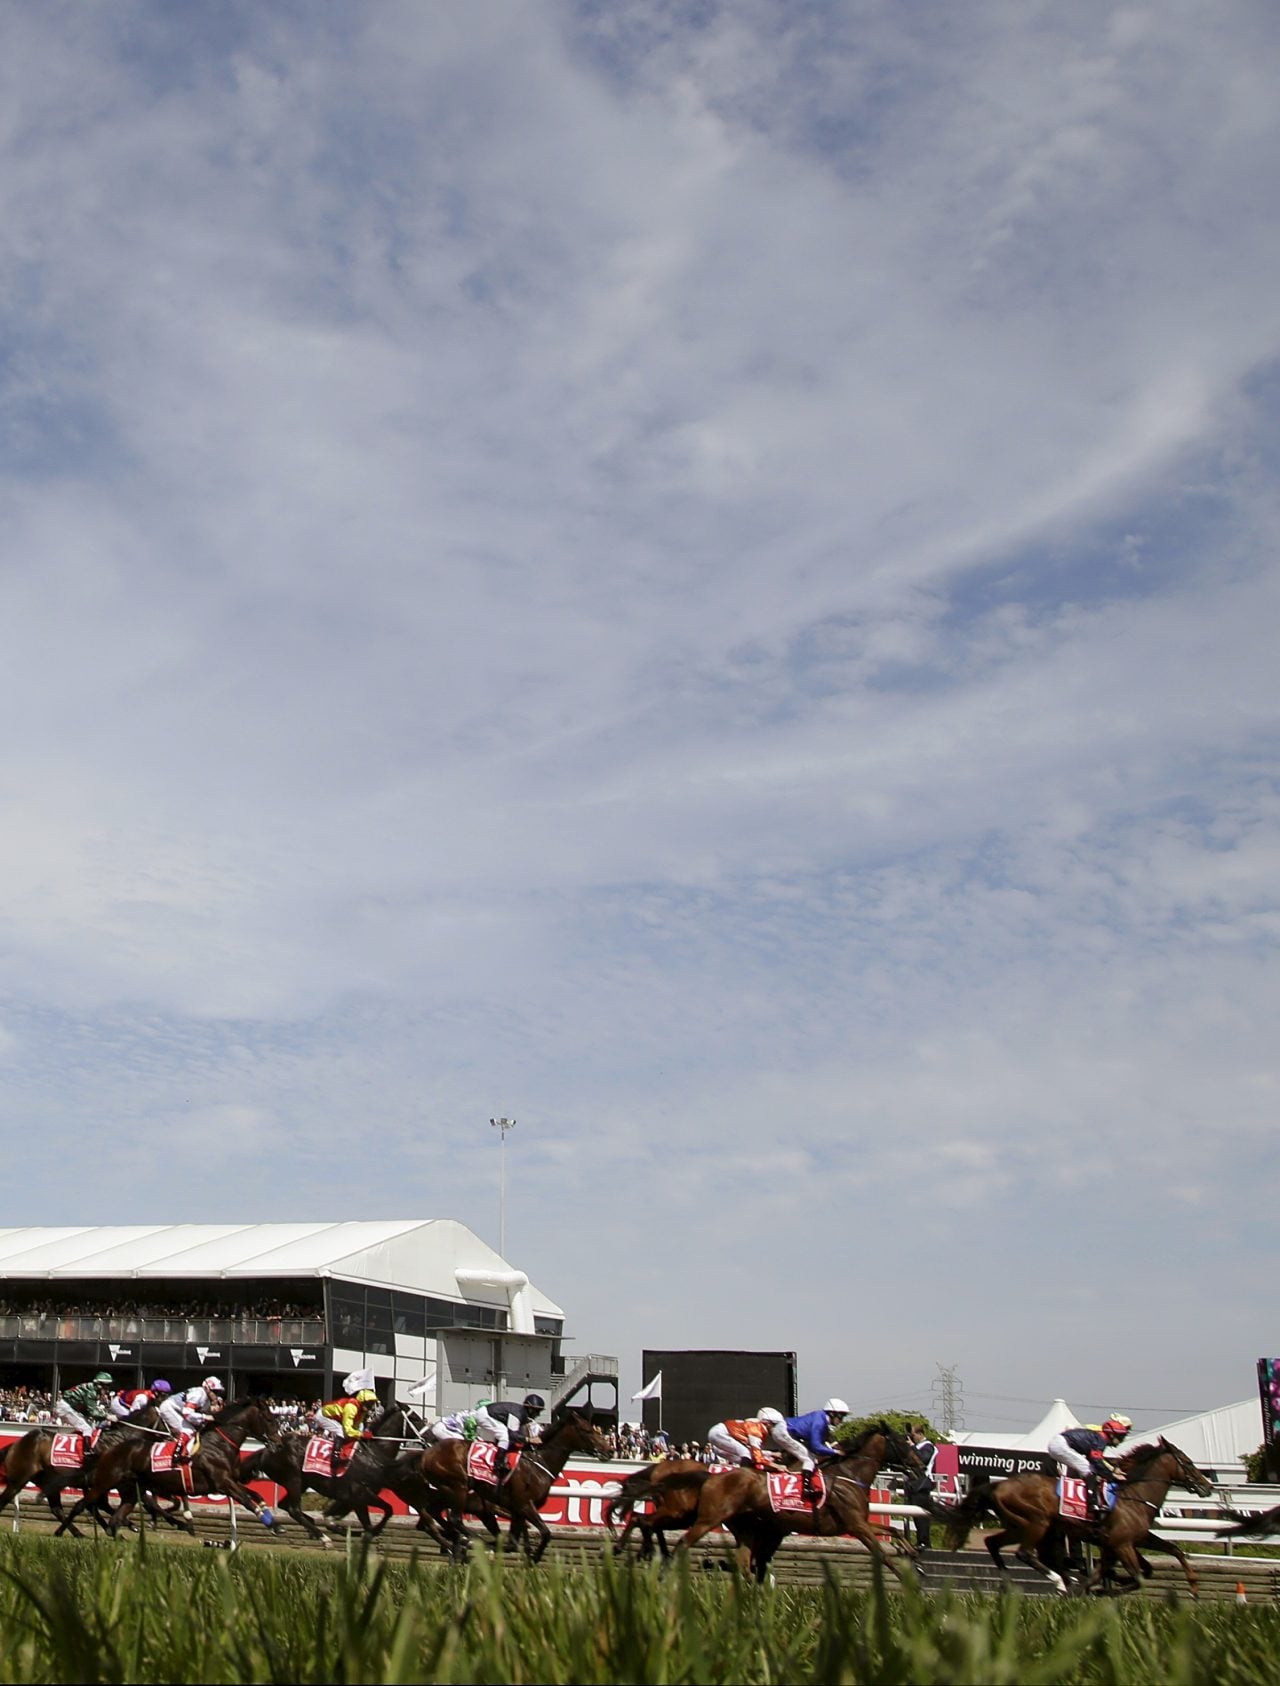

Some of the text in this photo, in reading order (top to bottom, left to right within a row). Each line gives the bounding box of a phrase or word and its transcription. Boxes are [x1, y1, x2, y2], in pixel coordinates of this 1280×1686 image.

[54, 1435, 78, 1453] 21
[959, 1453, 1043, 1473] winning pos
[769, 1474, 799, 1495] 12
